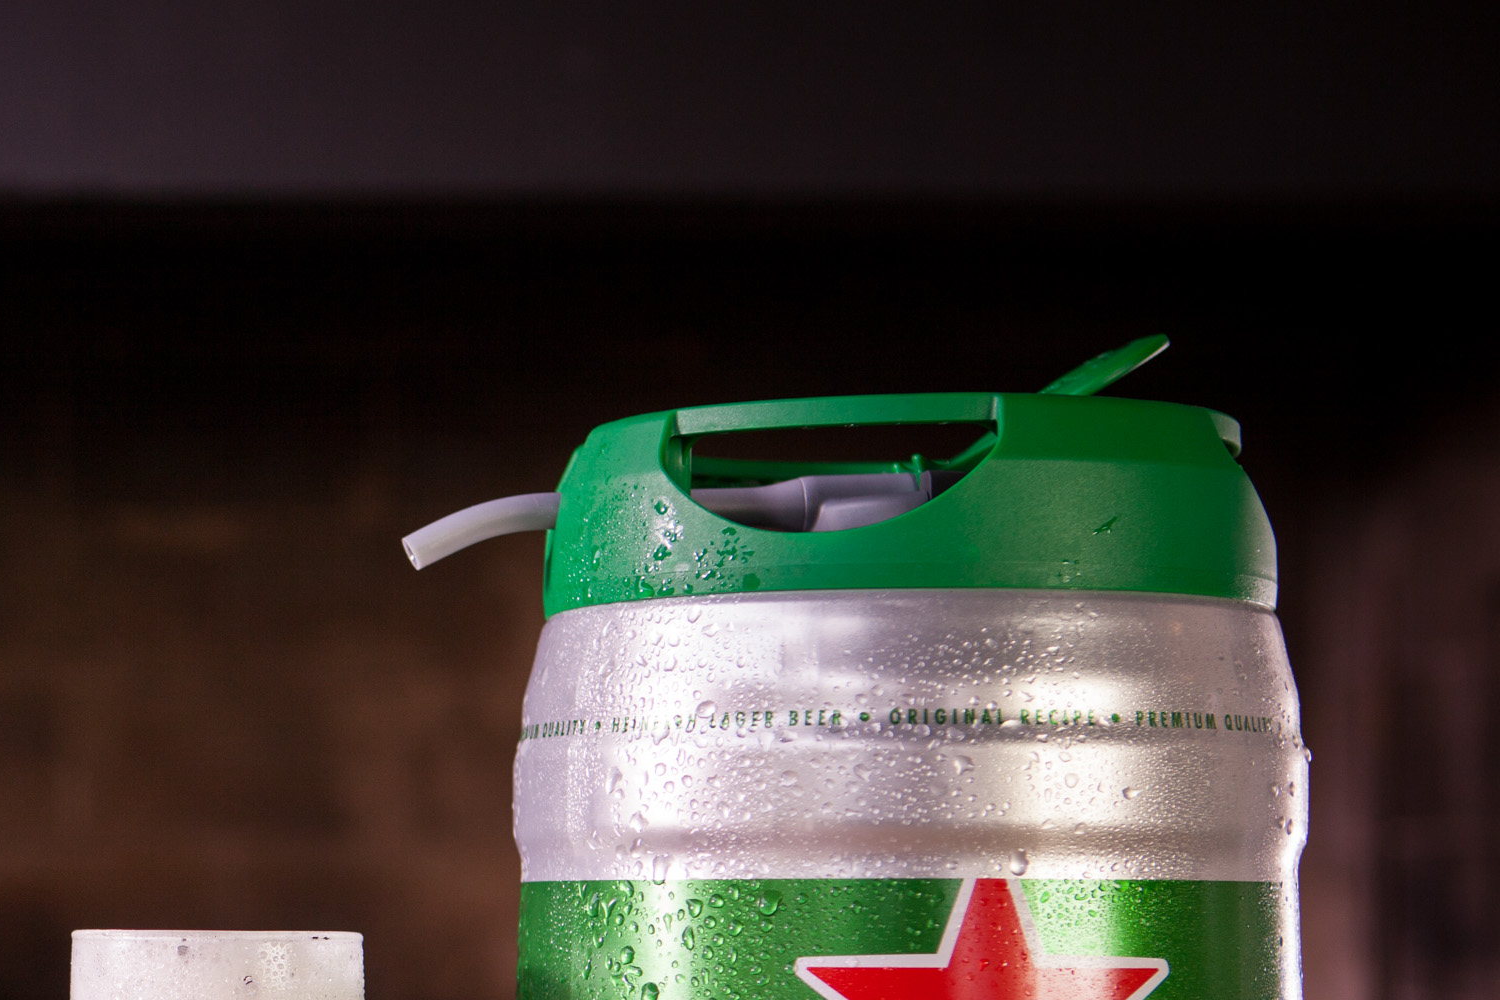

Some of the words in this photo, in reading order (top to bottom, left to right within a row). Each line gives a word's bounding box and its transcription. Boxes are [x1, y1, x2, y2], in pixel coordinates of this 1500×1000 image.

[709, 710, 773, 730] LAGER
[788, 709, 842, 727] BEER
[889, 708, 1001, 725] ORIGINAL
[1020, 708, 1097, 726] RECIPE
[1136, 710, 1217, 730] PREMIUM
[1224, 713, 1273, 734] QUALITY
